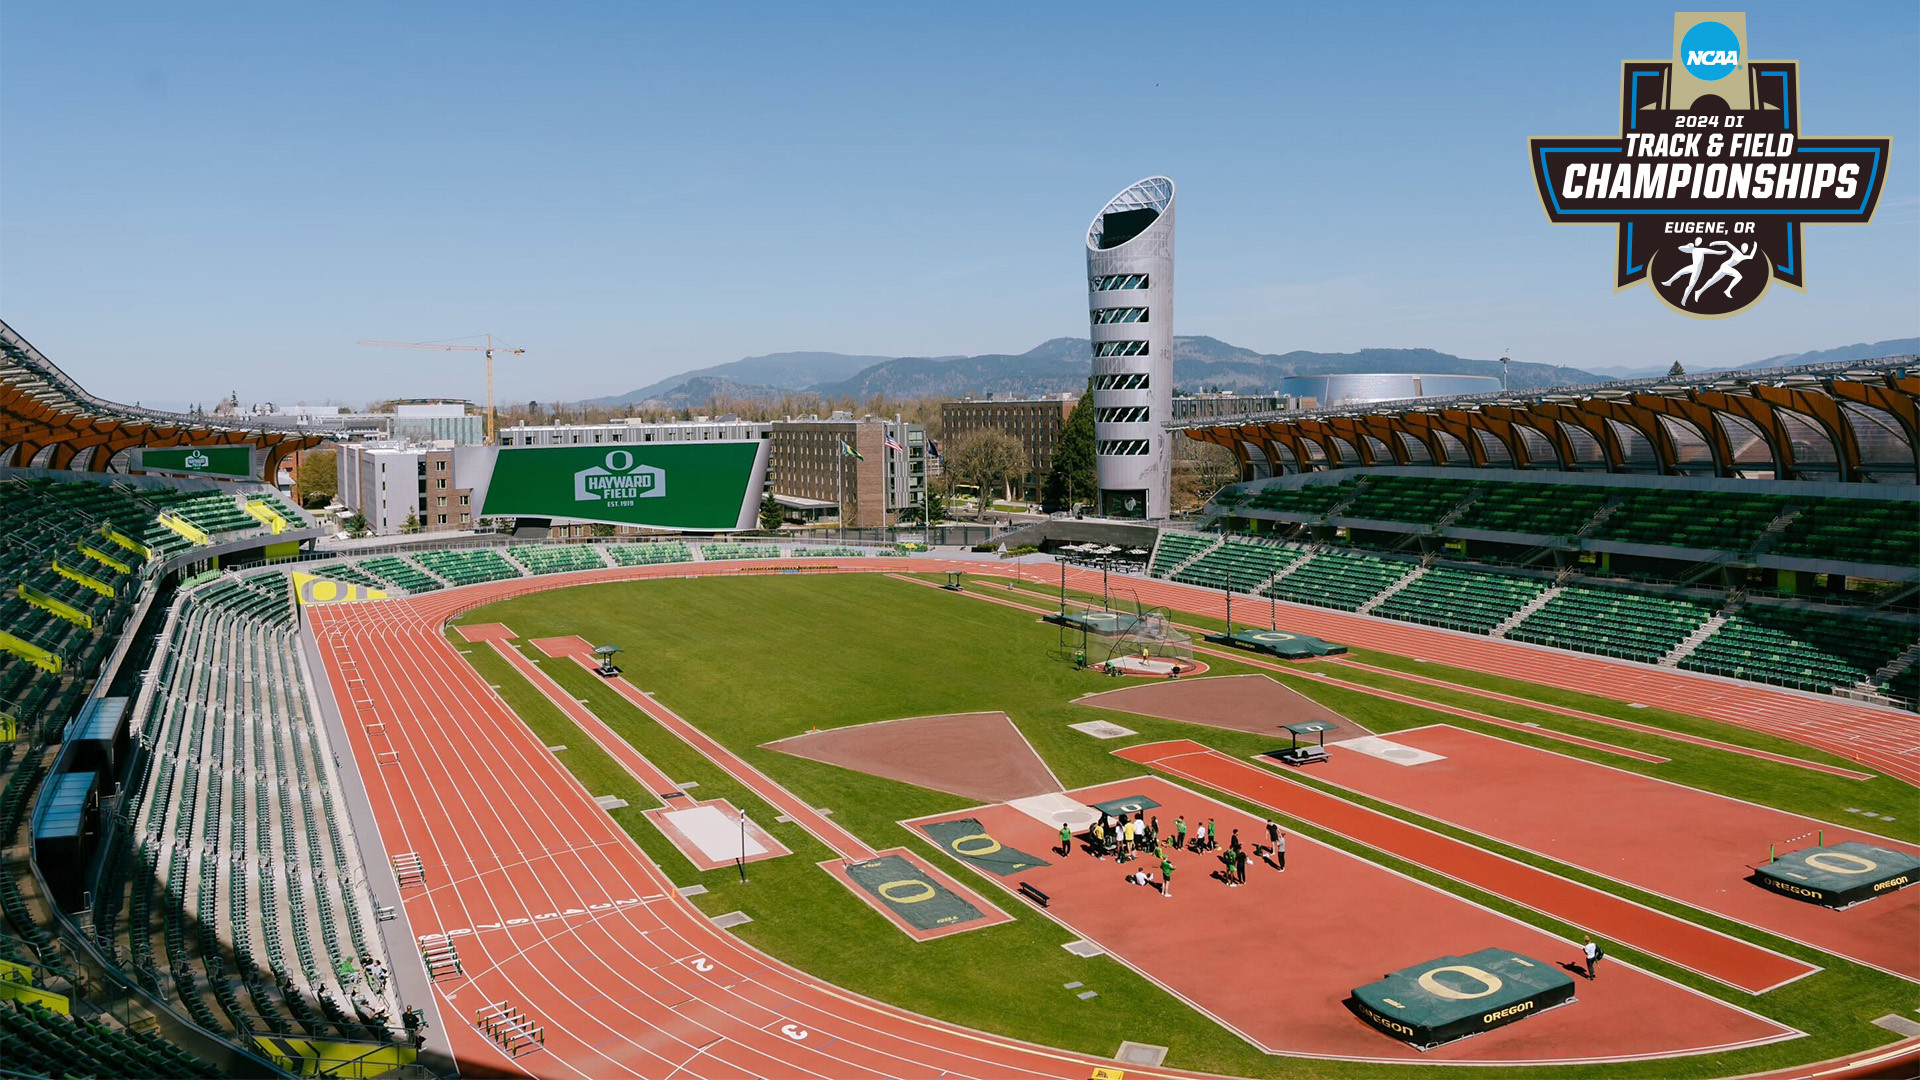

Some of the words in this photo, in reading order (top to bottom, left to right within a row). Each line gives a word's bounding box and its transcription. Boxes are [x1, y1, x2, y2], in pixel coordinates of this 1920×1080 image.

[605, 450, 634, 471] O
[588, 475, 652, 490] HAYWARD
[603, 487, 637, 499] FIELD
[1764, 877, 1823, 900] OREGON
[1873, 875, 1908, 892] OREGON
[690, 957, 715, 973] 2
[1417, 965, 1503, 1000] O
[1482, 1000, 1534, 1025] OREGON
[780, 1023, 809, 1041] 3
